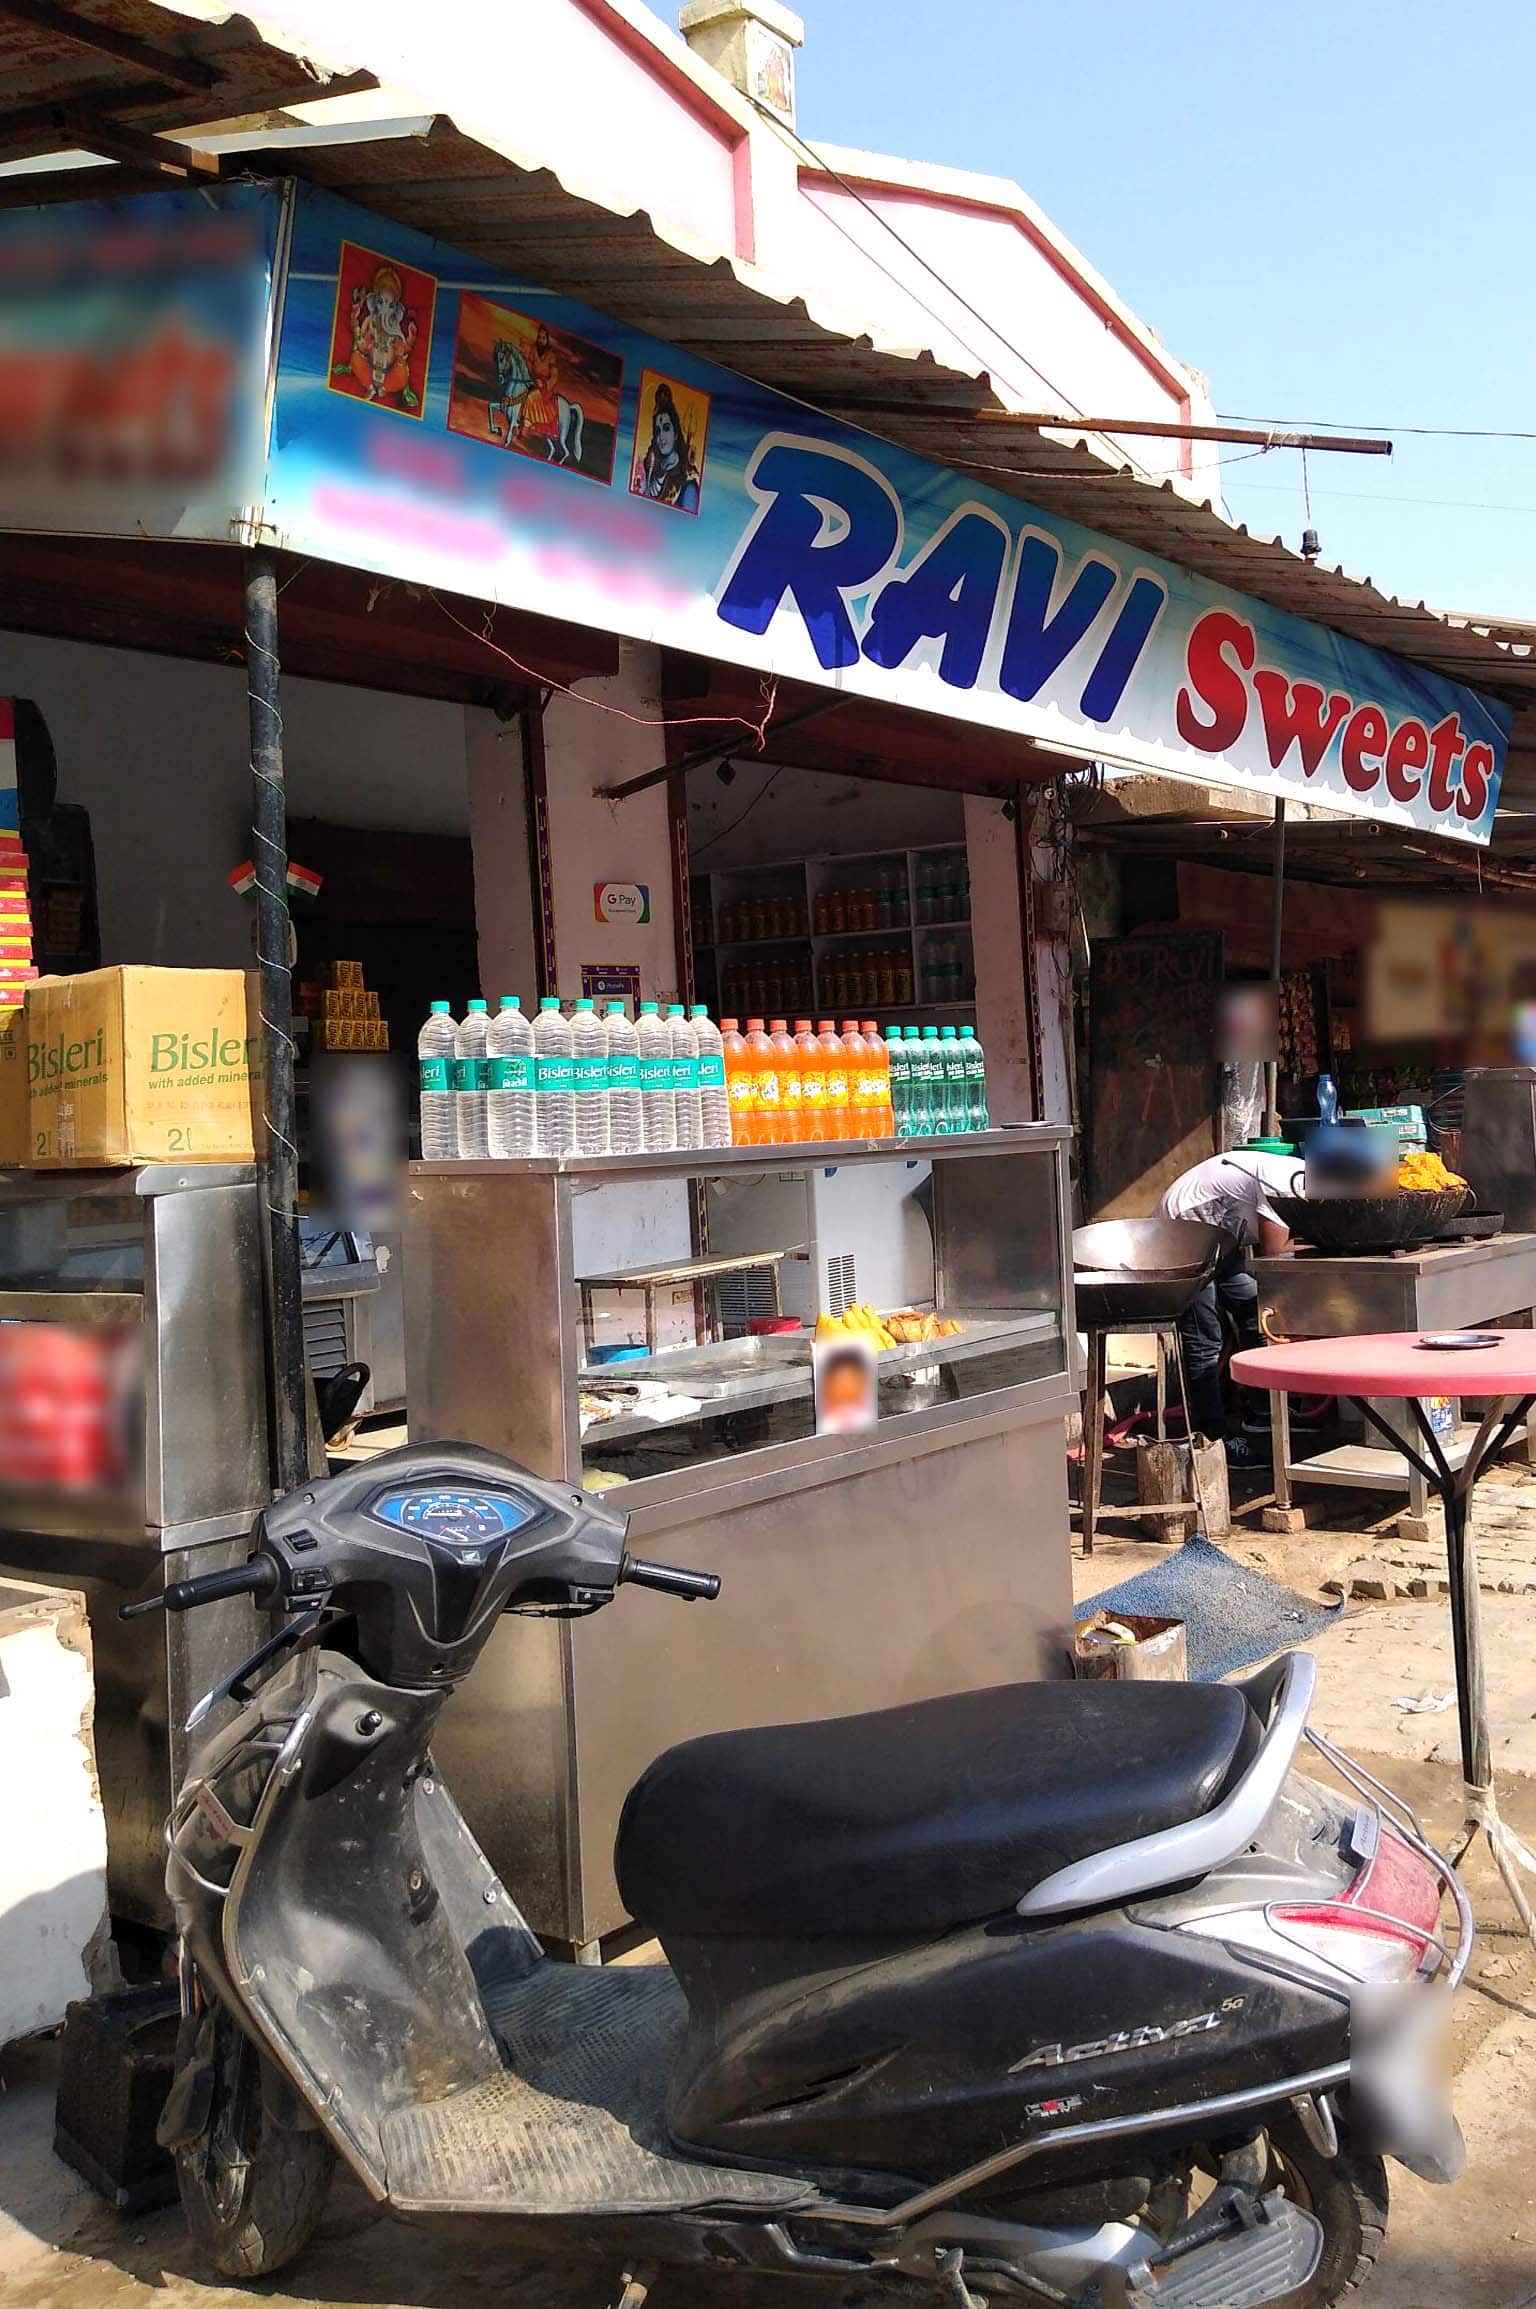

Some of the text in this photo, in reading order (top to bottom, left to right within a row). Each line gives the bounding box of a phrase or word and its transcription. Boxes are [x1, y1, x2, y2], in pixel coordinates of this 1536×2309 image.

[716, 433, 1168, 724] RAVI
[1176, 608, 1495, 824] Sweets
[619, 894, 636, 907] Pay
[607, 1063, 636, 1077] isleri
[64, 1072, 109, 1090] minerals
[148, 1077, 174, 1090] with
[176, 1073, 215, 1088] added
[1007, 2012, 1222, 2074] Activa
